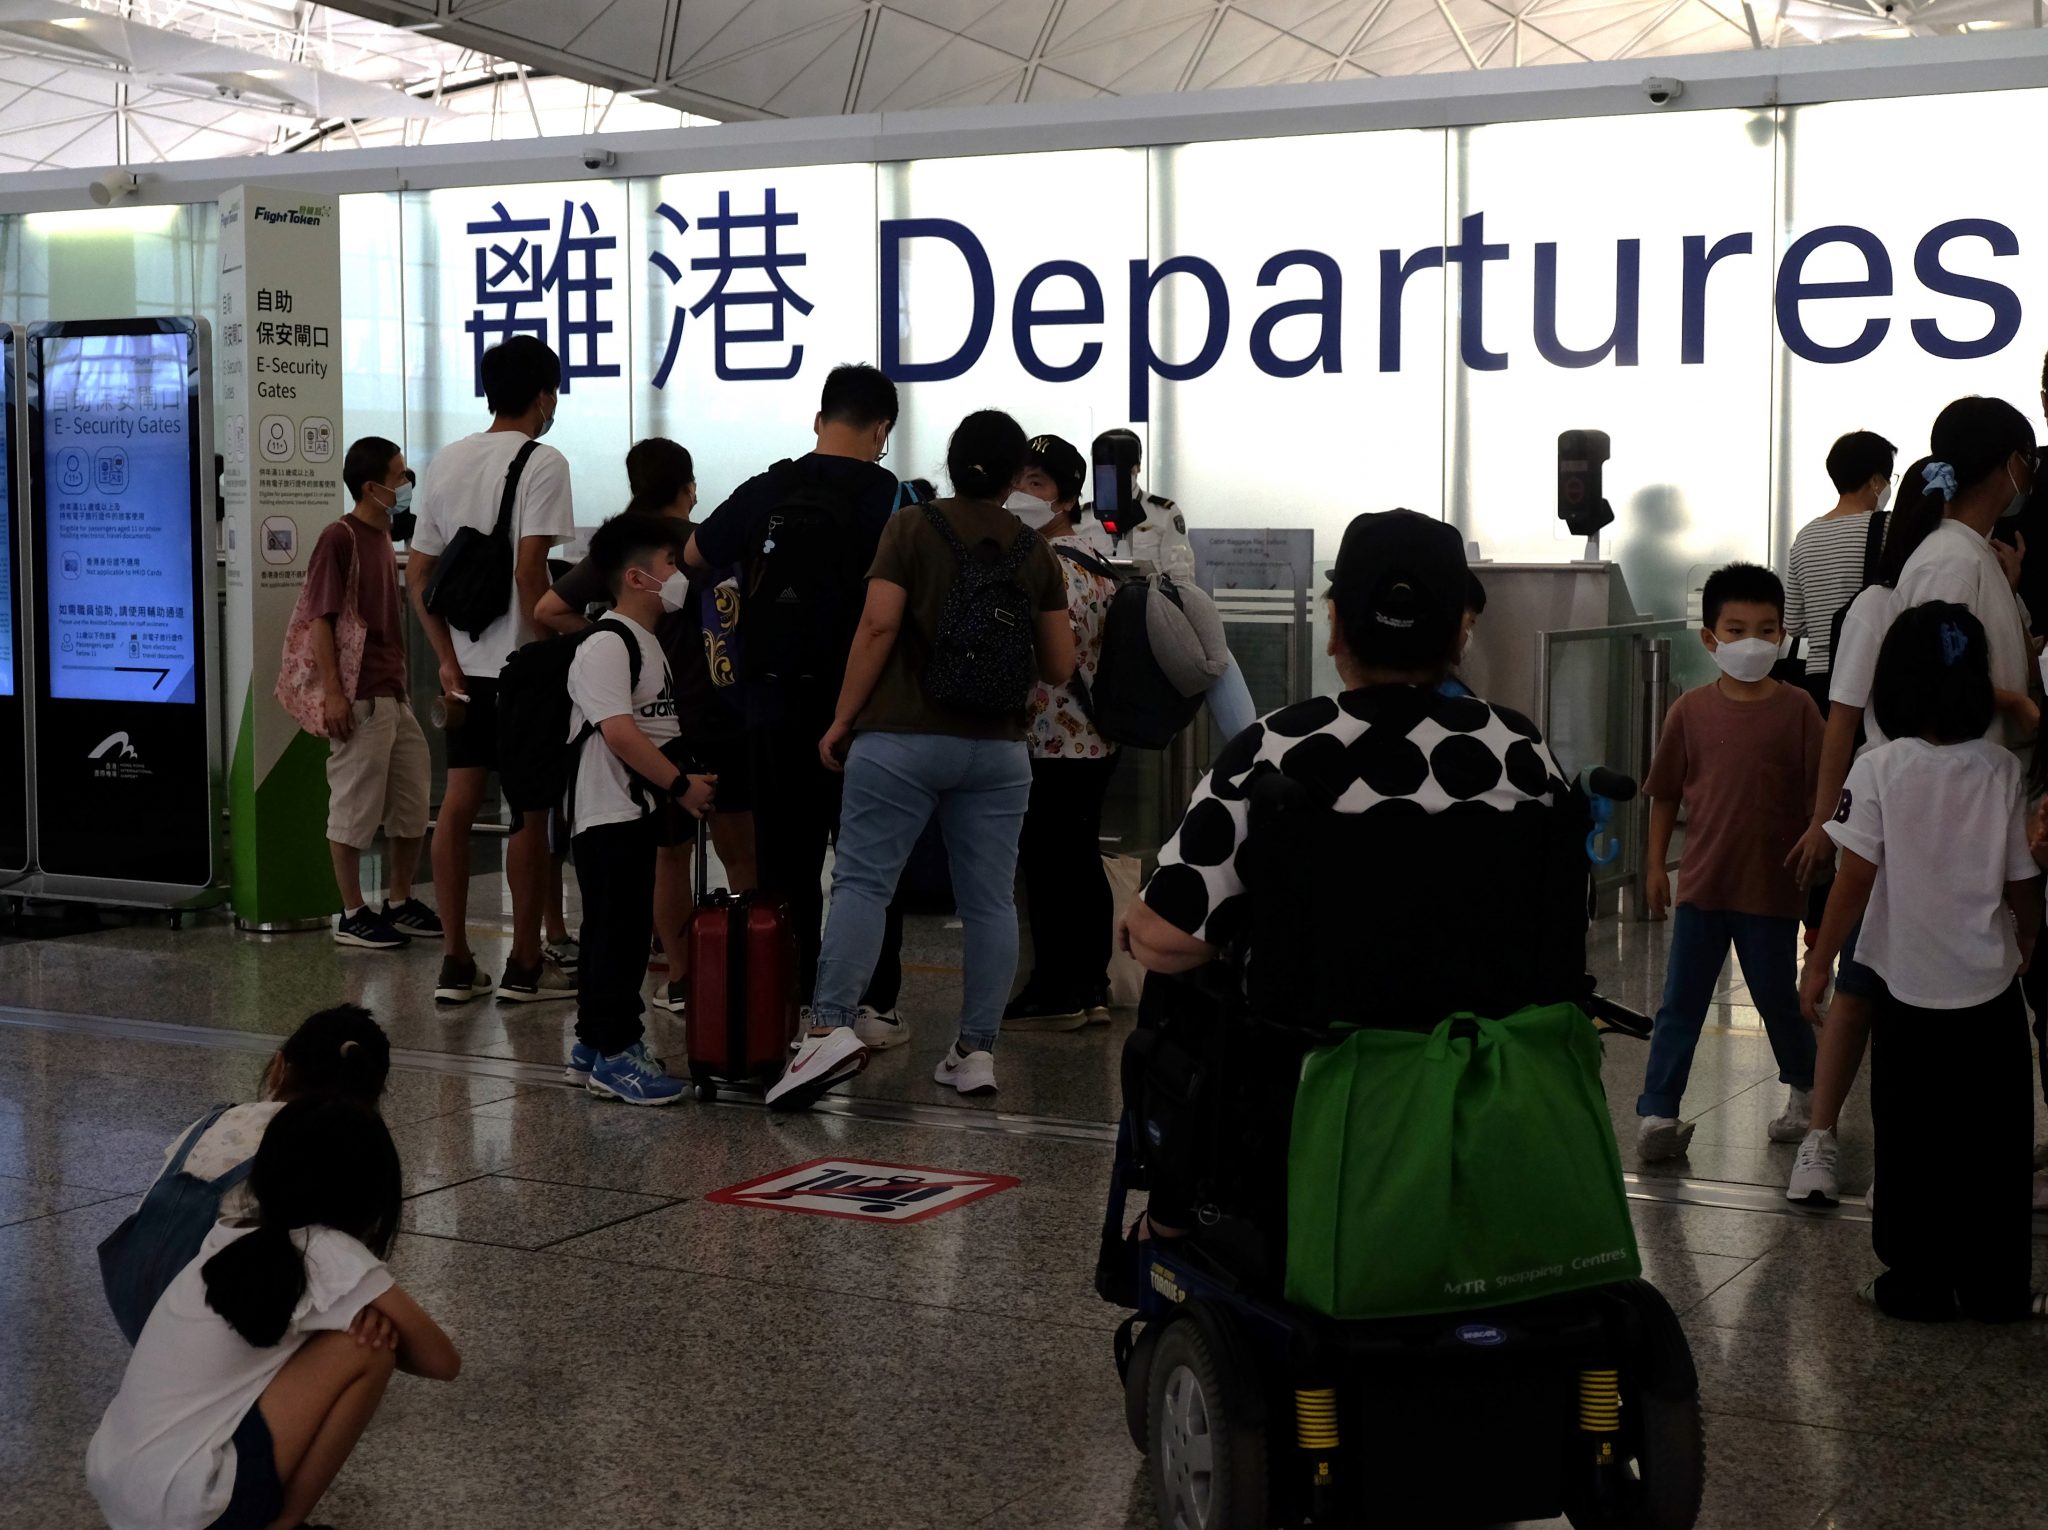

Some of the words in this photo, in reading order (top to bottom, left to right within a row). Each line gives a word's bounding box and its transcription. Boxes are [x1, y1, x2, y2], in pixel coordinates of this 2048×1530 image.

[257, 288, 292, 313] 自助
[465, 188, 814, 398] 離港
[879, 211, 2022, 423] Departures
[256, 321, 329, 348] 保安閘口
[257, 356, 328, 380] E-Security
[257, 382, 297, 399] Gates
[138, 416, 181, 434] Gates
[1444, 1279, 1487, 1295] MTR
[1495, 1264, 1564, 1288] Shopping
[1571, 1247, 1627, 1271] Centres
